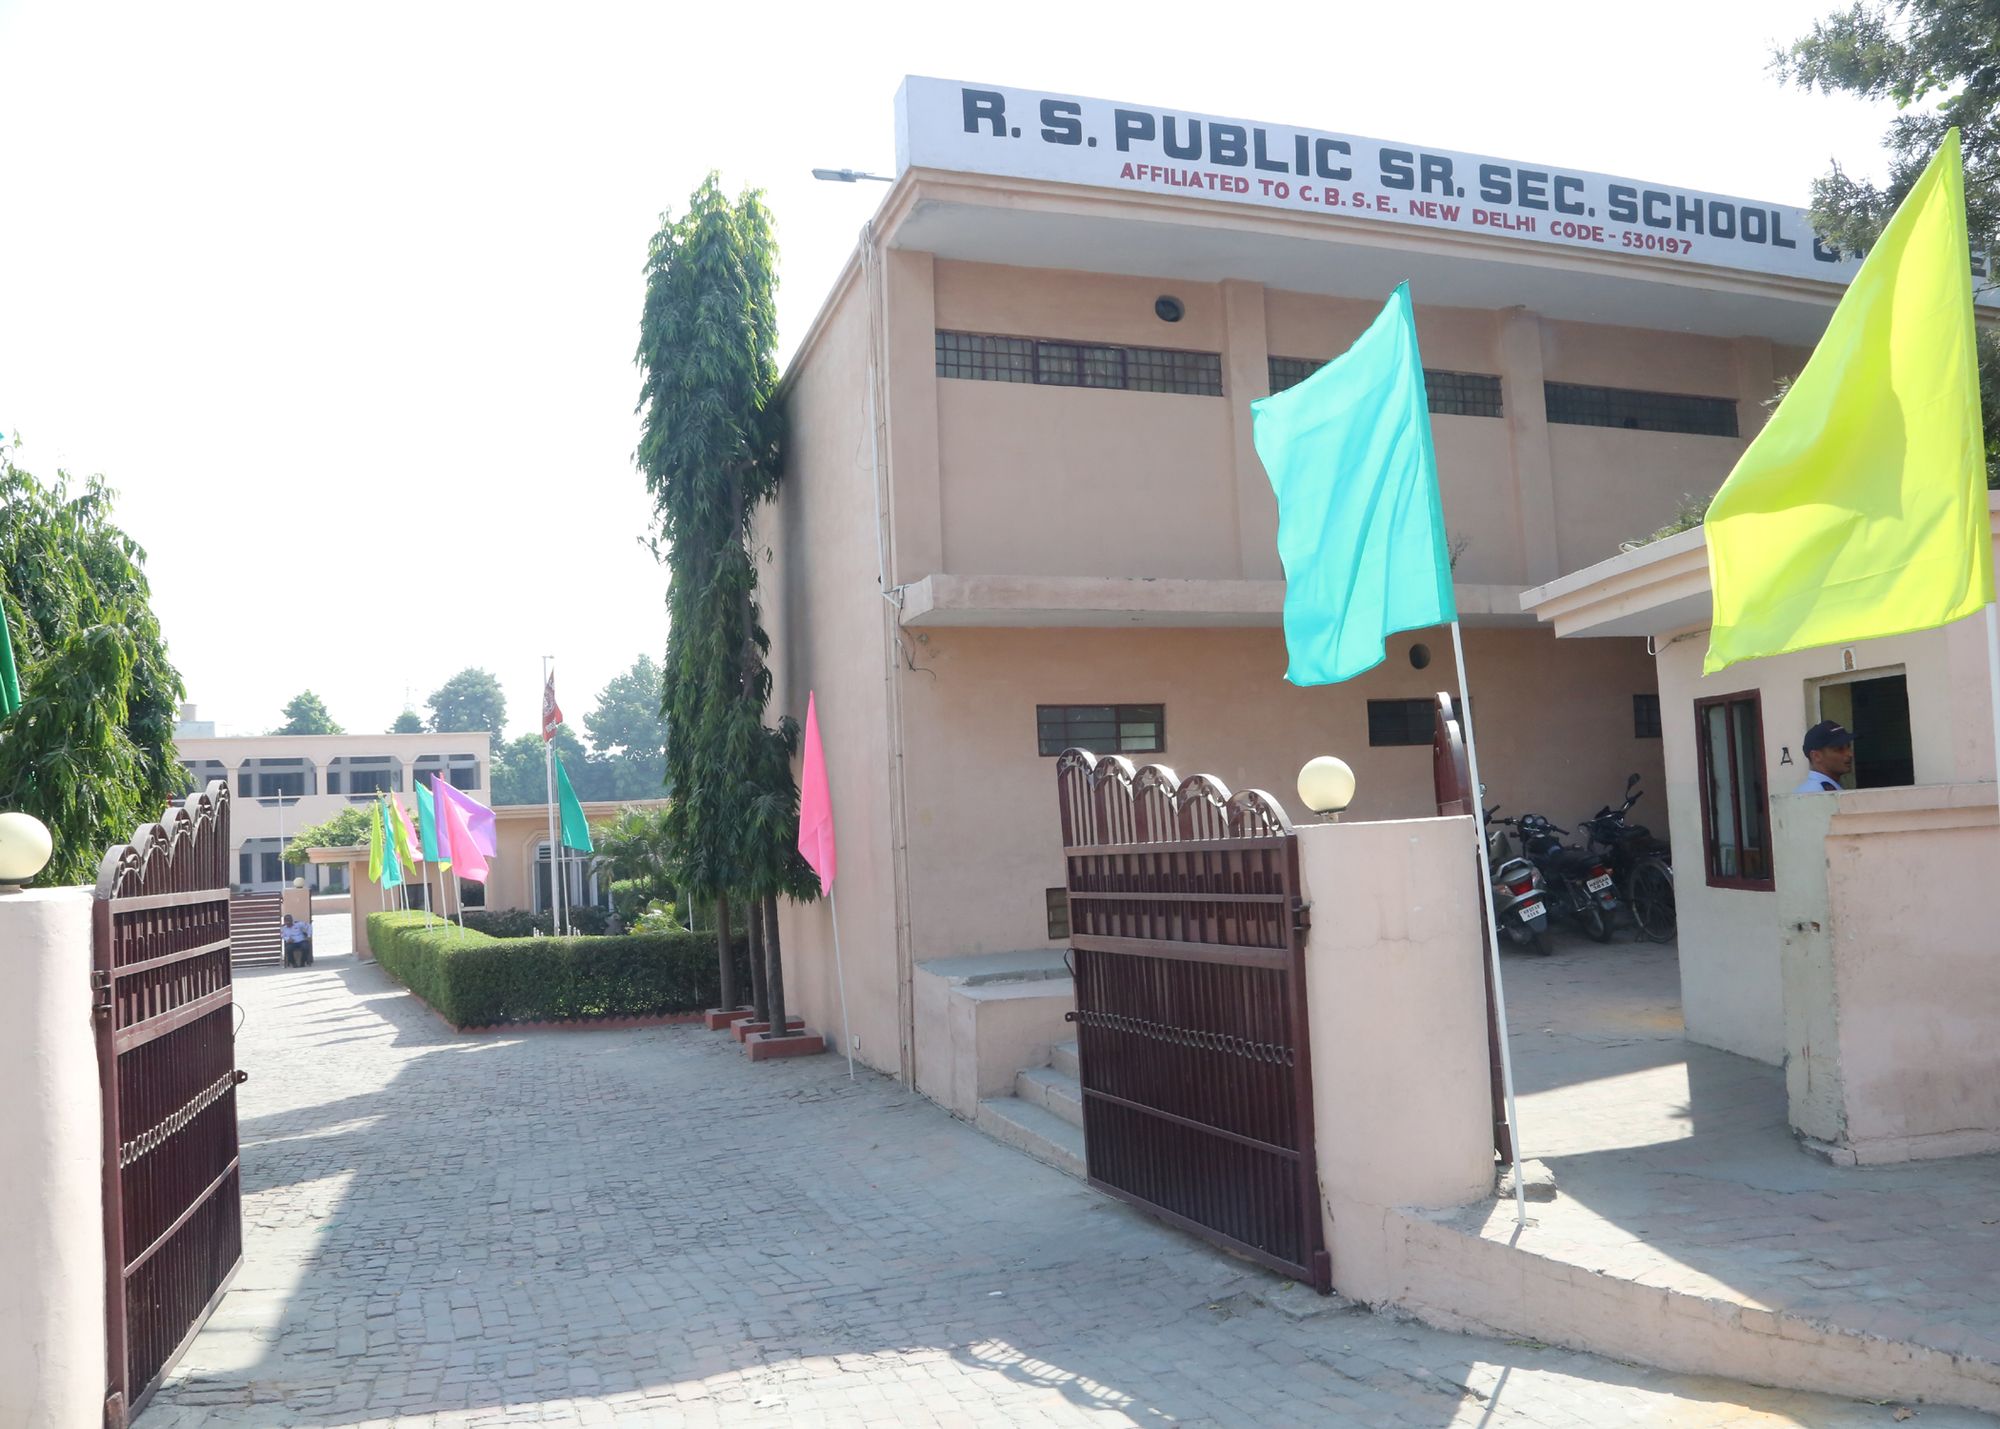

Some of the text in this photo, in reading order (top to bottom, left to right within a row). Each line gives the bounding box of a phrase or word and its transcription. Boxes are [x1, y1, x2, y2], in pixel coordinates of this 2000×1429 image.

[962, 88, 1796, 249] R. S. PUBLIC SR. SEC. SCHOOL
[1120, 162, 1250, 194] AFFILIATED
[1258, 178, 1290, 199] TO
[1409, 200, 1460, 222] NEW
[1472, 209, 1536, 232] DELHI
